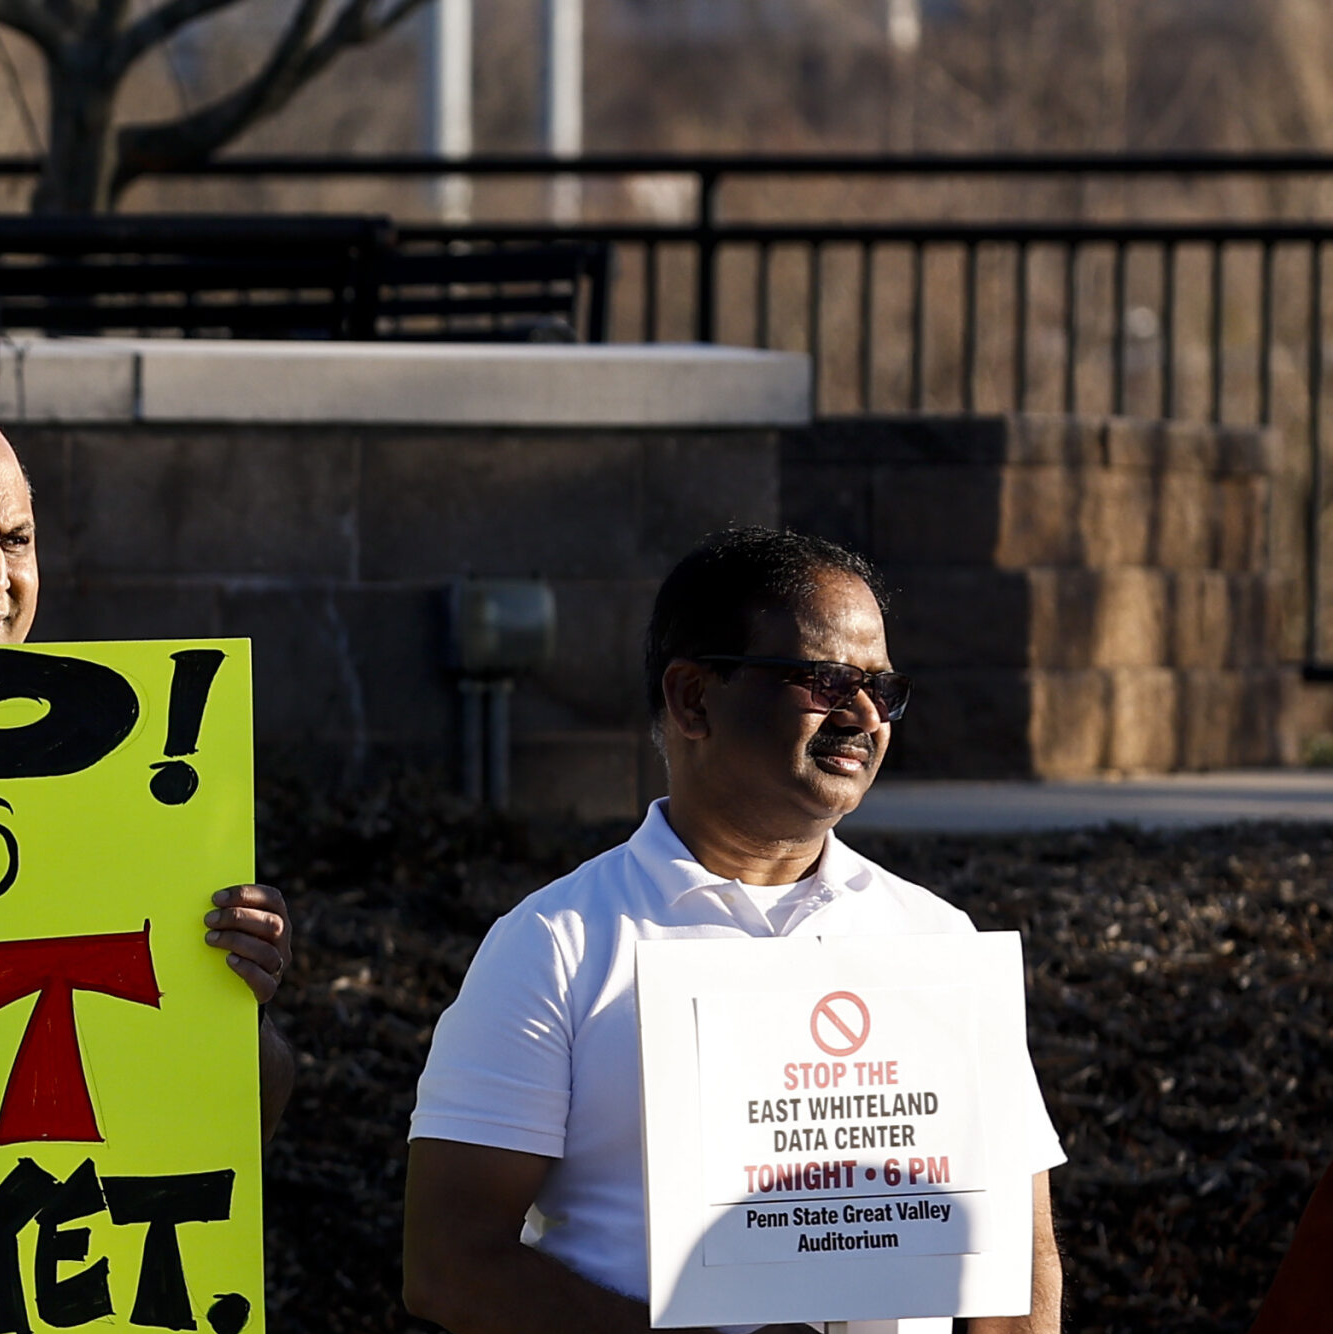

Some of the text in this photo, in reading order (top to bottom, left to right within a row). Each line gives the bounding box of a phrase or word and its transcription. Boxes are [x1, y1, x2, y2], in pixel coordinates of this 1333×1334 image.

[783, 1061, 899, 1090] STOP THE
[748, 1091, 939, 1123] EAST WHITELAND
[774, 1124, 915, 1153] DATA CENTER
[744, 1160, 857, 1193] TONIGHT
[883, 1158, 900, 1186] 6
[909, 1156, 950, 1184] PM
[746, 1200, 951, 1228] Penn State Great Valley
[798, 1230, 899, 1253] Auditorium
